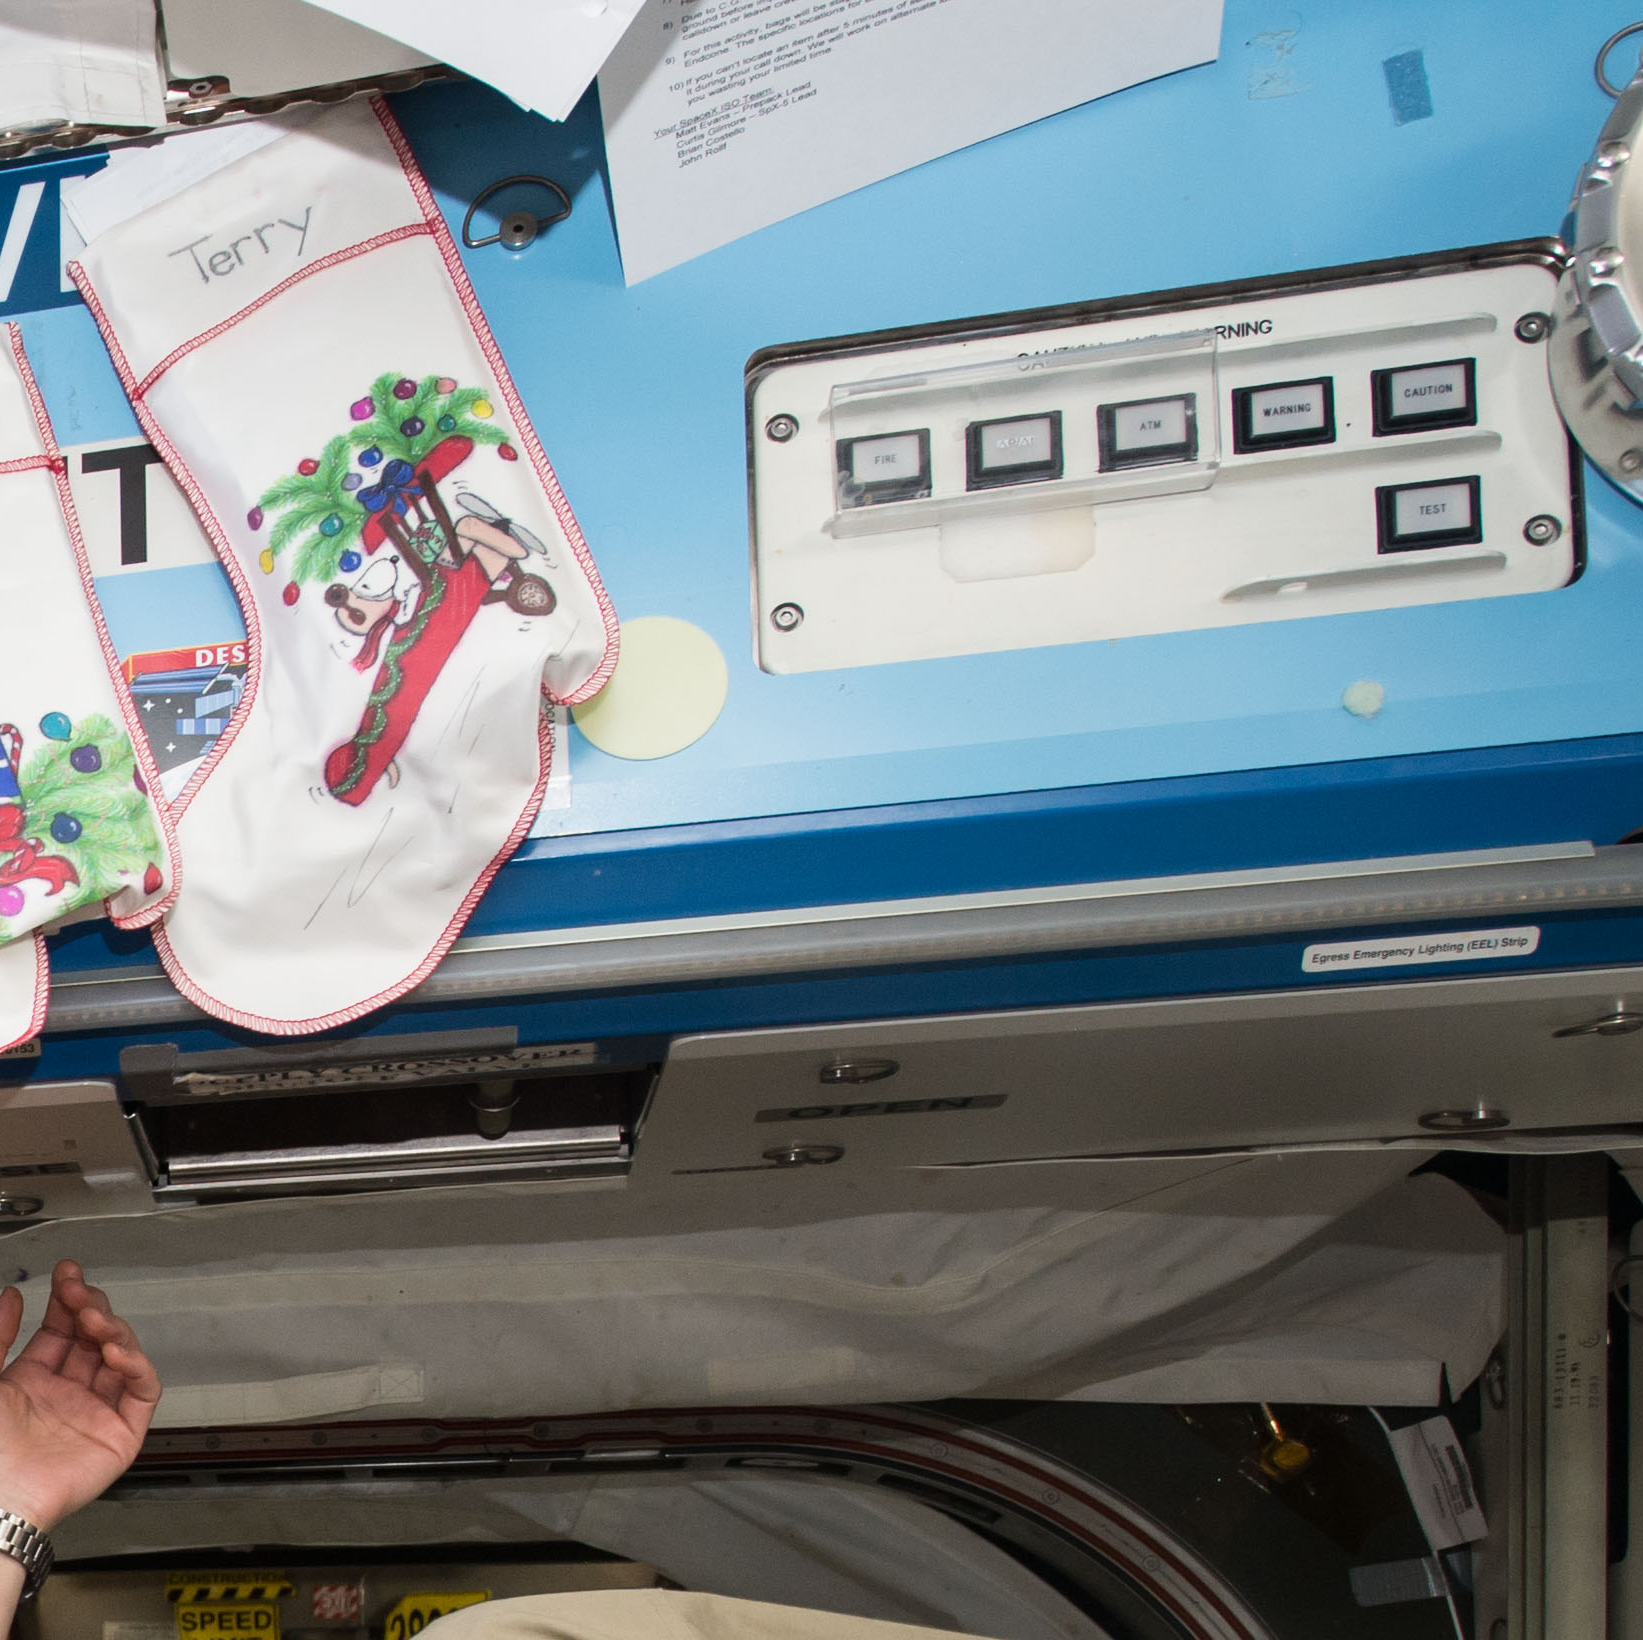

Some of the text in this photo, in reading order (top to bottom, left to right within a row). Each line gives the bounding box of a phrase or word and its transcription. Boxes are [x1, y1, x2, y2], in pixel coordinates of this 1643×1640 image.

[682, 11, 703, 24] Due
[682, 5, 771, 40] calldown or leave
[683, 3, 754, 33] ground before
[684, 4, 826, 58] For this bags will be
[736, 6, 845, 48] The specific locations
[670, 7, 893, 92] 10) you locate an item after minutes
[695, 77, 726, 92] during
[729, 67, 750, 81] your
[754, 59, 771, 70] call
[807, 40, 825, 51] We
[828, 33, 844, 43] will
[847, 24, 870, 37] work
[874, 18, 887, 26] on
[688, 54, 807, 107] you wasting your limited
[654, 99, 740, 138] Your SpaceX ISO
[675, 80, 811, 139] Matt Evans Prepack Lead
[676, 134, 705, 149] Curtis
[708, 117, 746, 136] Gilmore
[791, 88, 817, 103] Lead
[677, 127, 746, 159] Brian Costello
[679, 154, 703, 168] John
[166, 206, 313, 284] Terry
[1404, 382, 1453, 399] CAUTION
[1139, 418, 1163, 433] ATM
[1263, 402, 1312, 418] WARNING
[874, 453, 897, 465] FIRE
[1419, 503, 1447, 517] TEST
[1312, 936, 1528, 965] Egress Emergency Lighting (EEL) Strip
[788, 1097, 975, 1119] OPEN
[181, 1609, 273, 1632] SPEED
